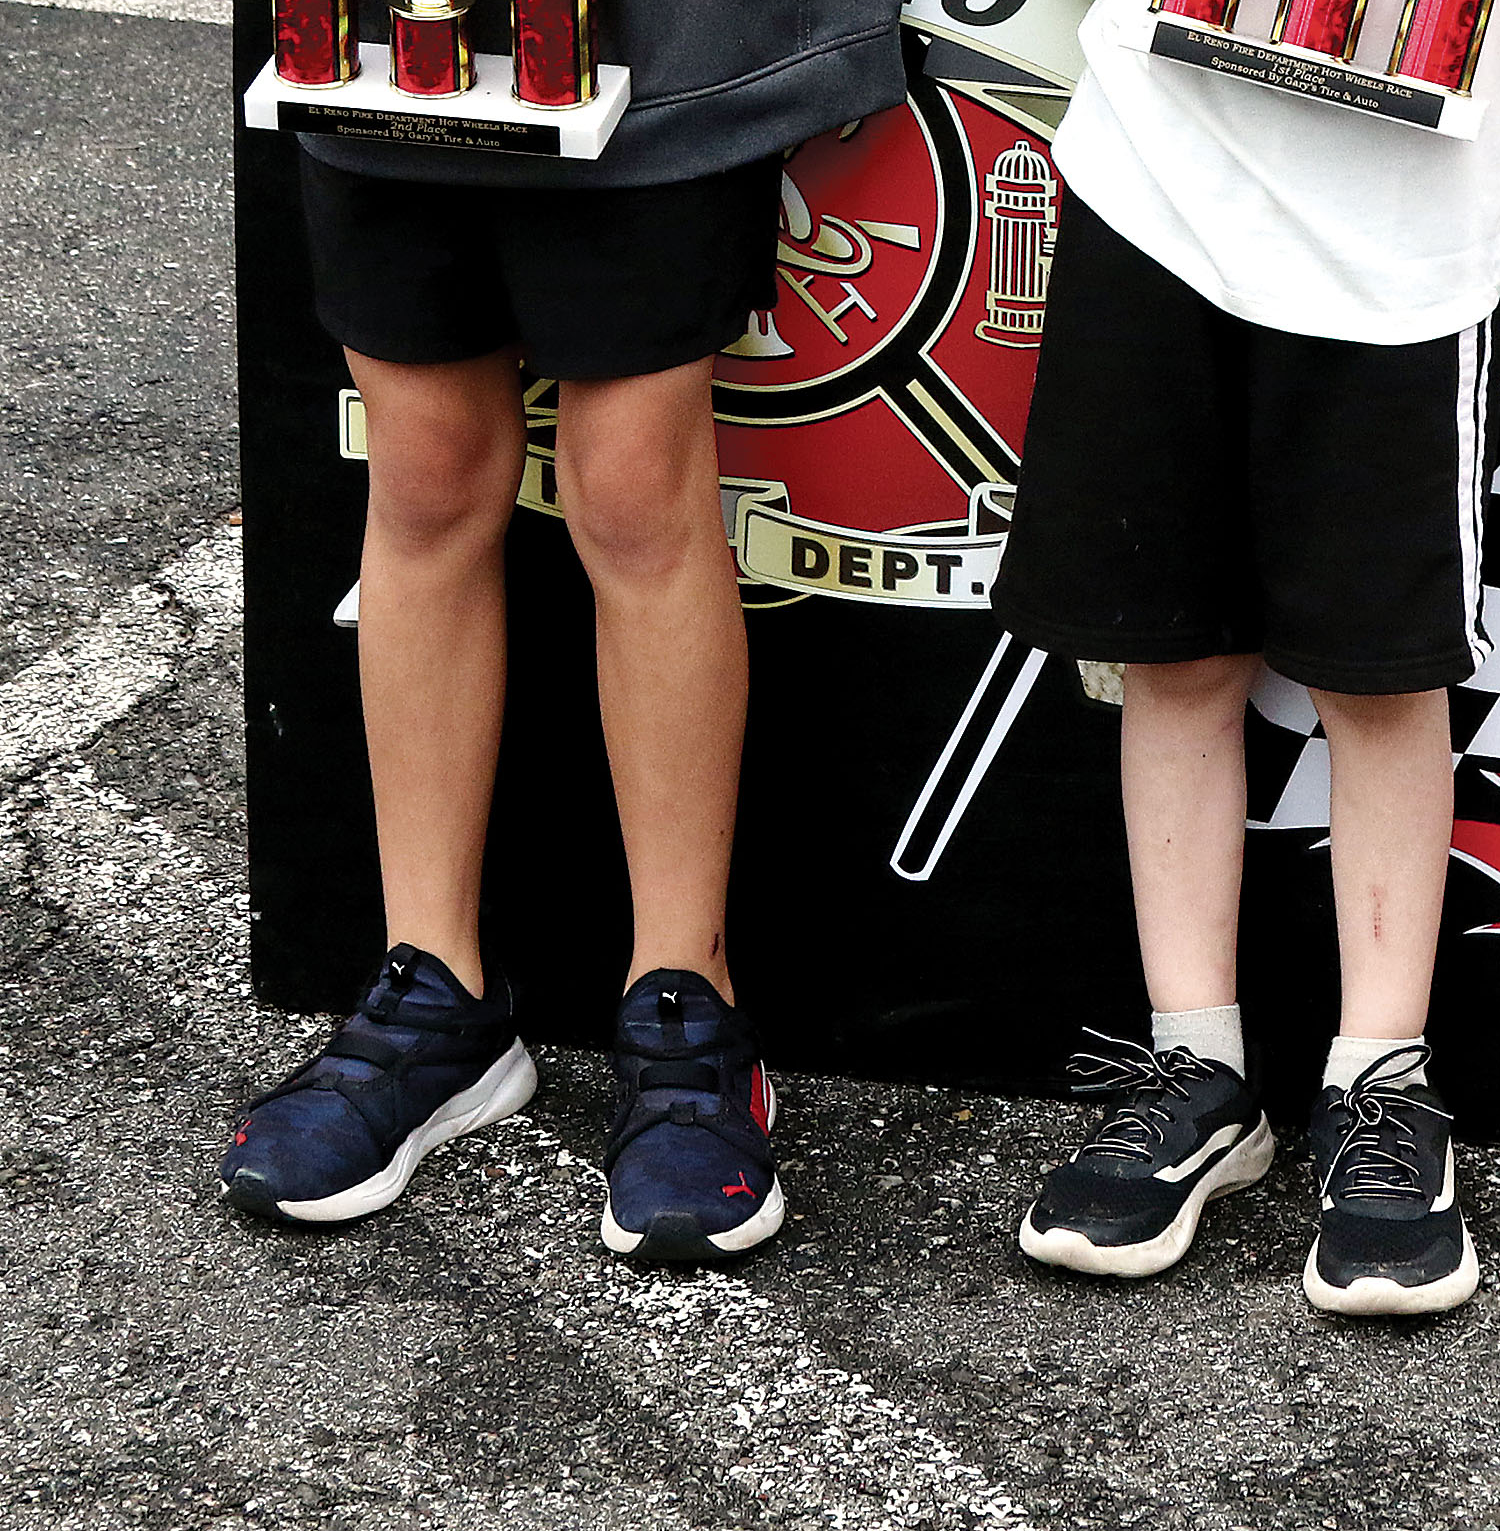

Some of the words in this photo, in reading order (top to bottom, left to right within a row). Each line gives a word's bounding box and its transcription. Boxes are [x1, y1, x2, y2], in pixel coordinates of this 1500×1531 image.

[1211, 56, 1265, 78] Sponsored
[1268, 71, 1282, 84] By
[1284, 76, 1318, 92] Gary's
[1319, 85, 1341, 98] Tire
[1342, 91, 1352, 101] &
[1353, 95, 1379, 108] Auto
[1272, 63, 1291, 75] 1st
[1293, 69, 1326, 84] Place
[336, 125, 389, 137] Sponsored
[392, 129, 405, 140] By
[408, 131, 440, 142] Gary's
[443, 134, 463, 144] Tire
[465, 136, 474, 145] &
[476, 137, 500, 147] Auto
[390, 121, 413, 131] 2nd
[416, 123, 448, 135] Place
[791, 535, 985, 596] DEPT.
